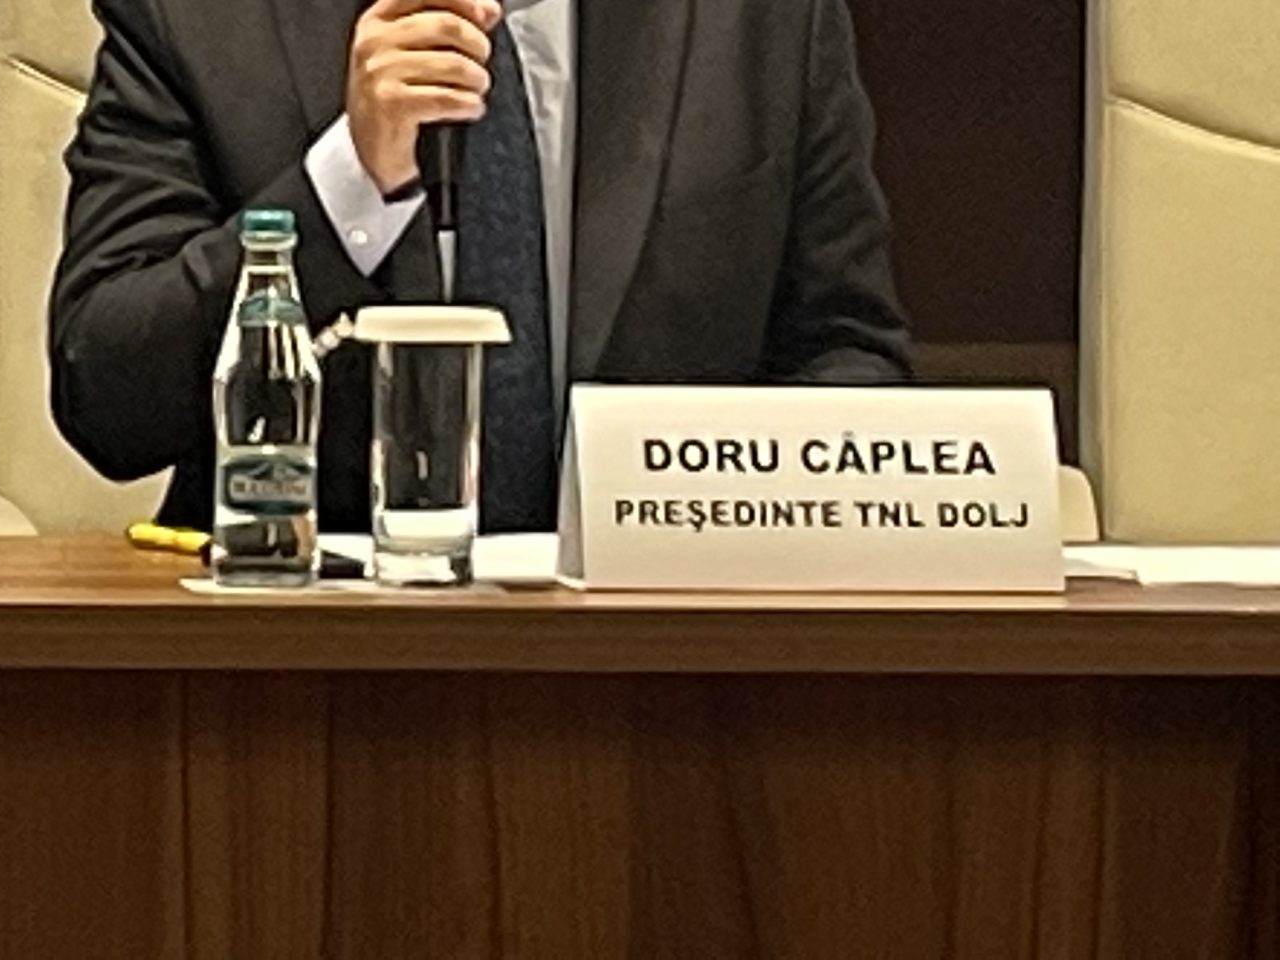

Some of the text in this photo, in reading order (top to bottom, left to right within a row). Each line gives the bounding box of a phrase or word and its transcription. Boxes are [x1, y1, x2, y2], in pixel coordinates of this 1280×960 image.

[643, 438, 780, 474] DORU
[853, 501, 926, 528] TNL
[937, 502, 1029, 529] DOLJ
